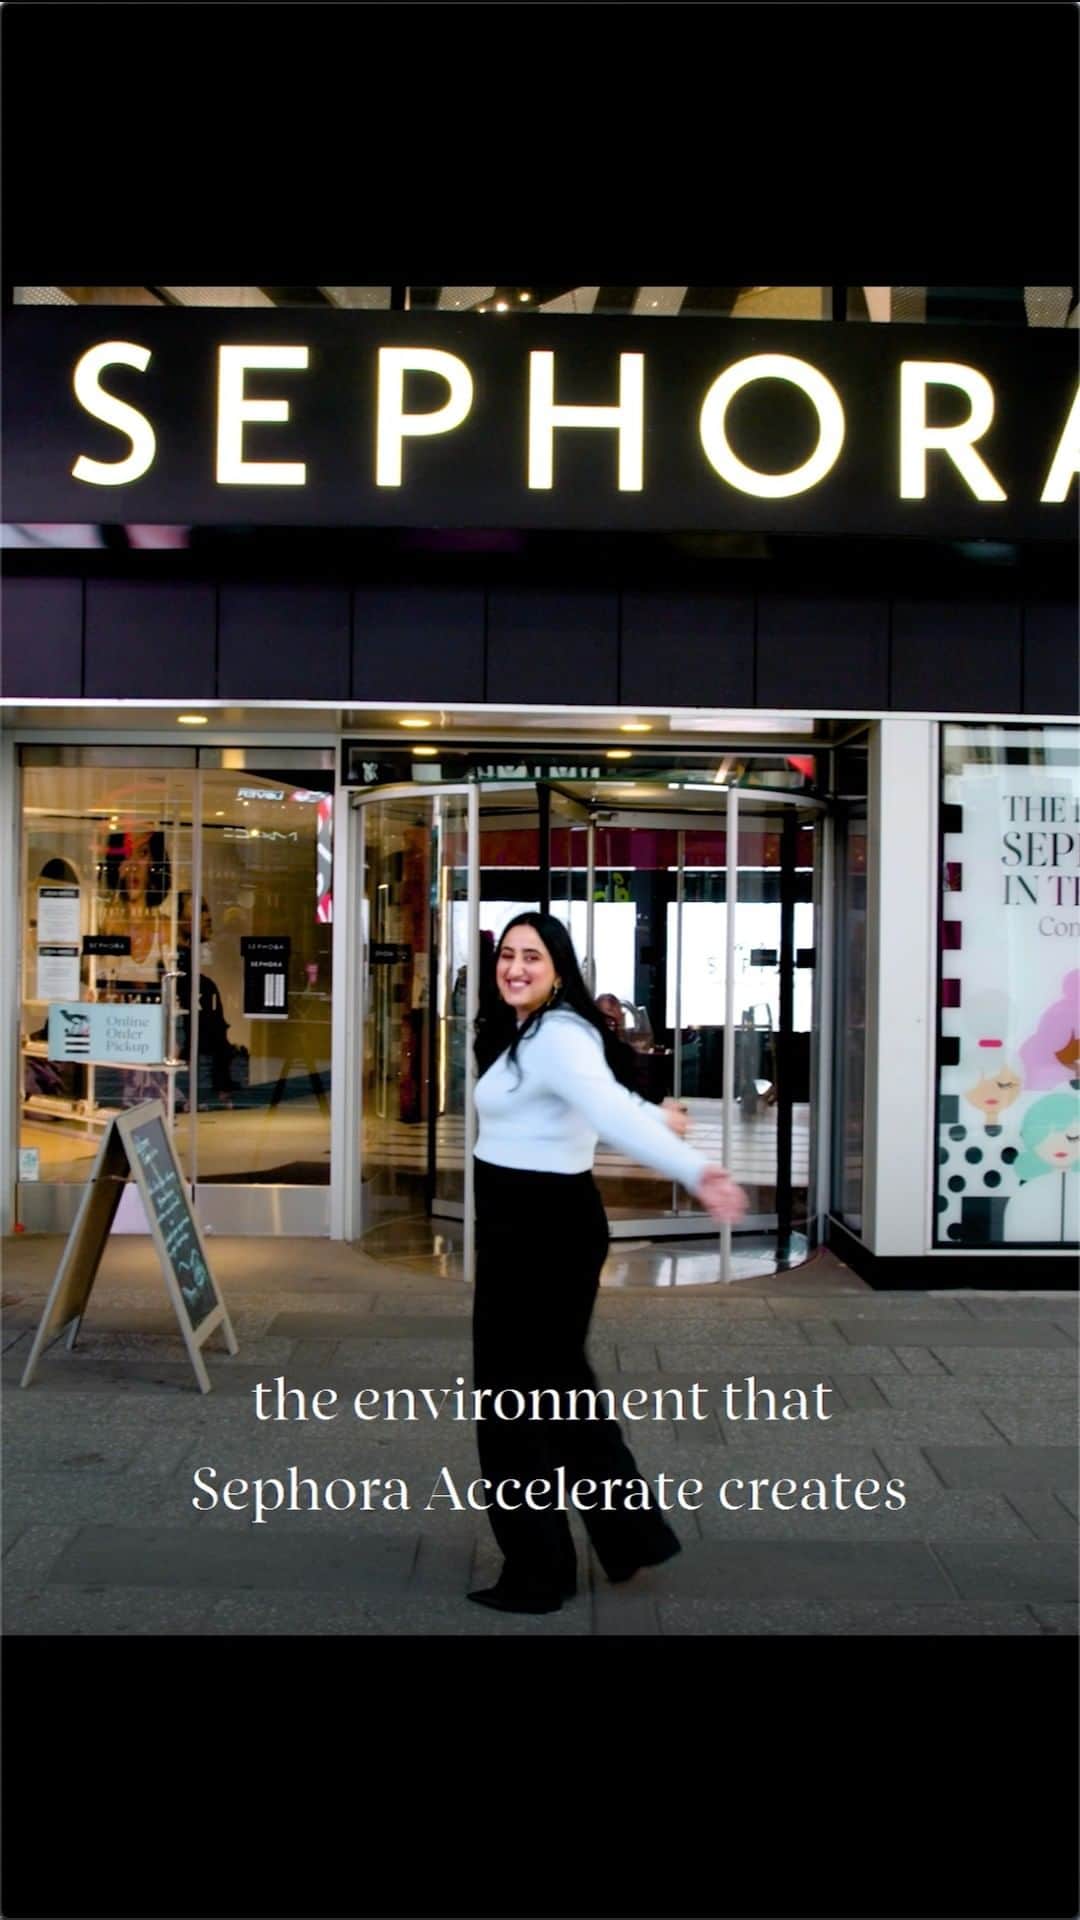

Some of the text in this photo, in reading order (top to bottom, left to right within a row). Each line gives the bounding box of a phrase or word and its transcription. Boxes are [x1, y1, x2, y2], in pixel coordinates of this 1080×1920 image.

[1002, 796, 1066, 823] THE
[1001, 831, 1080, 867] SEP
[1003, 874, 1039, 906] IN
[105, 1015, 150, 1027] Online
[105, 1027, 143, 1040] Order
[105, 1040, 150, 1056] Pickup
